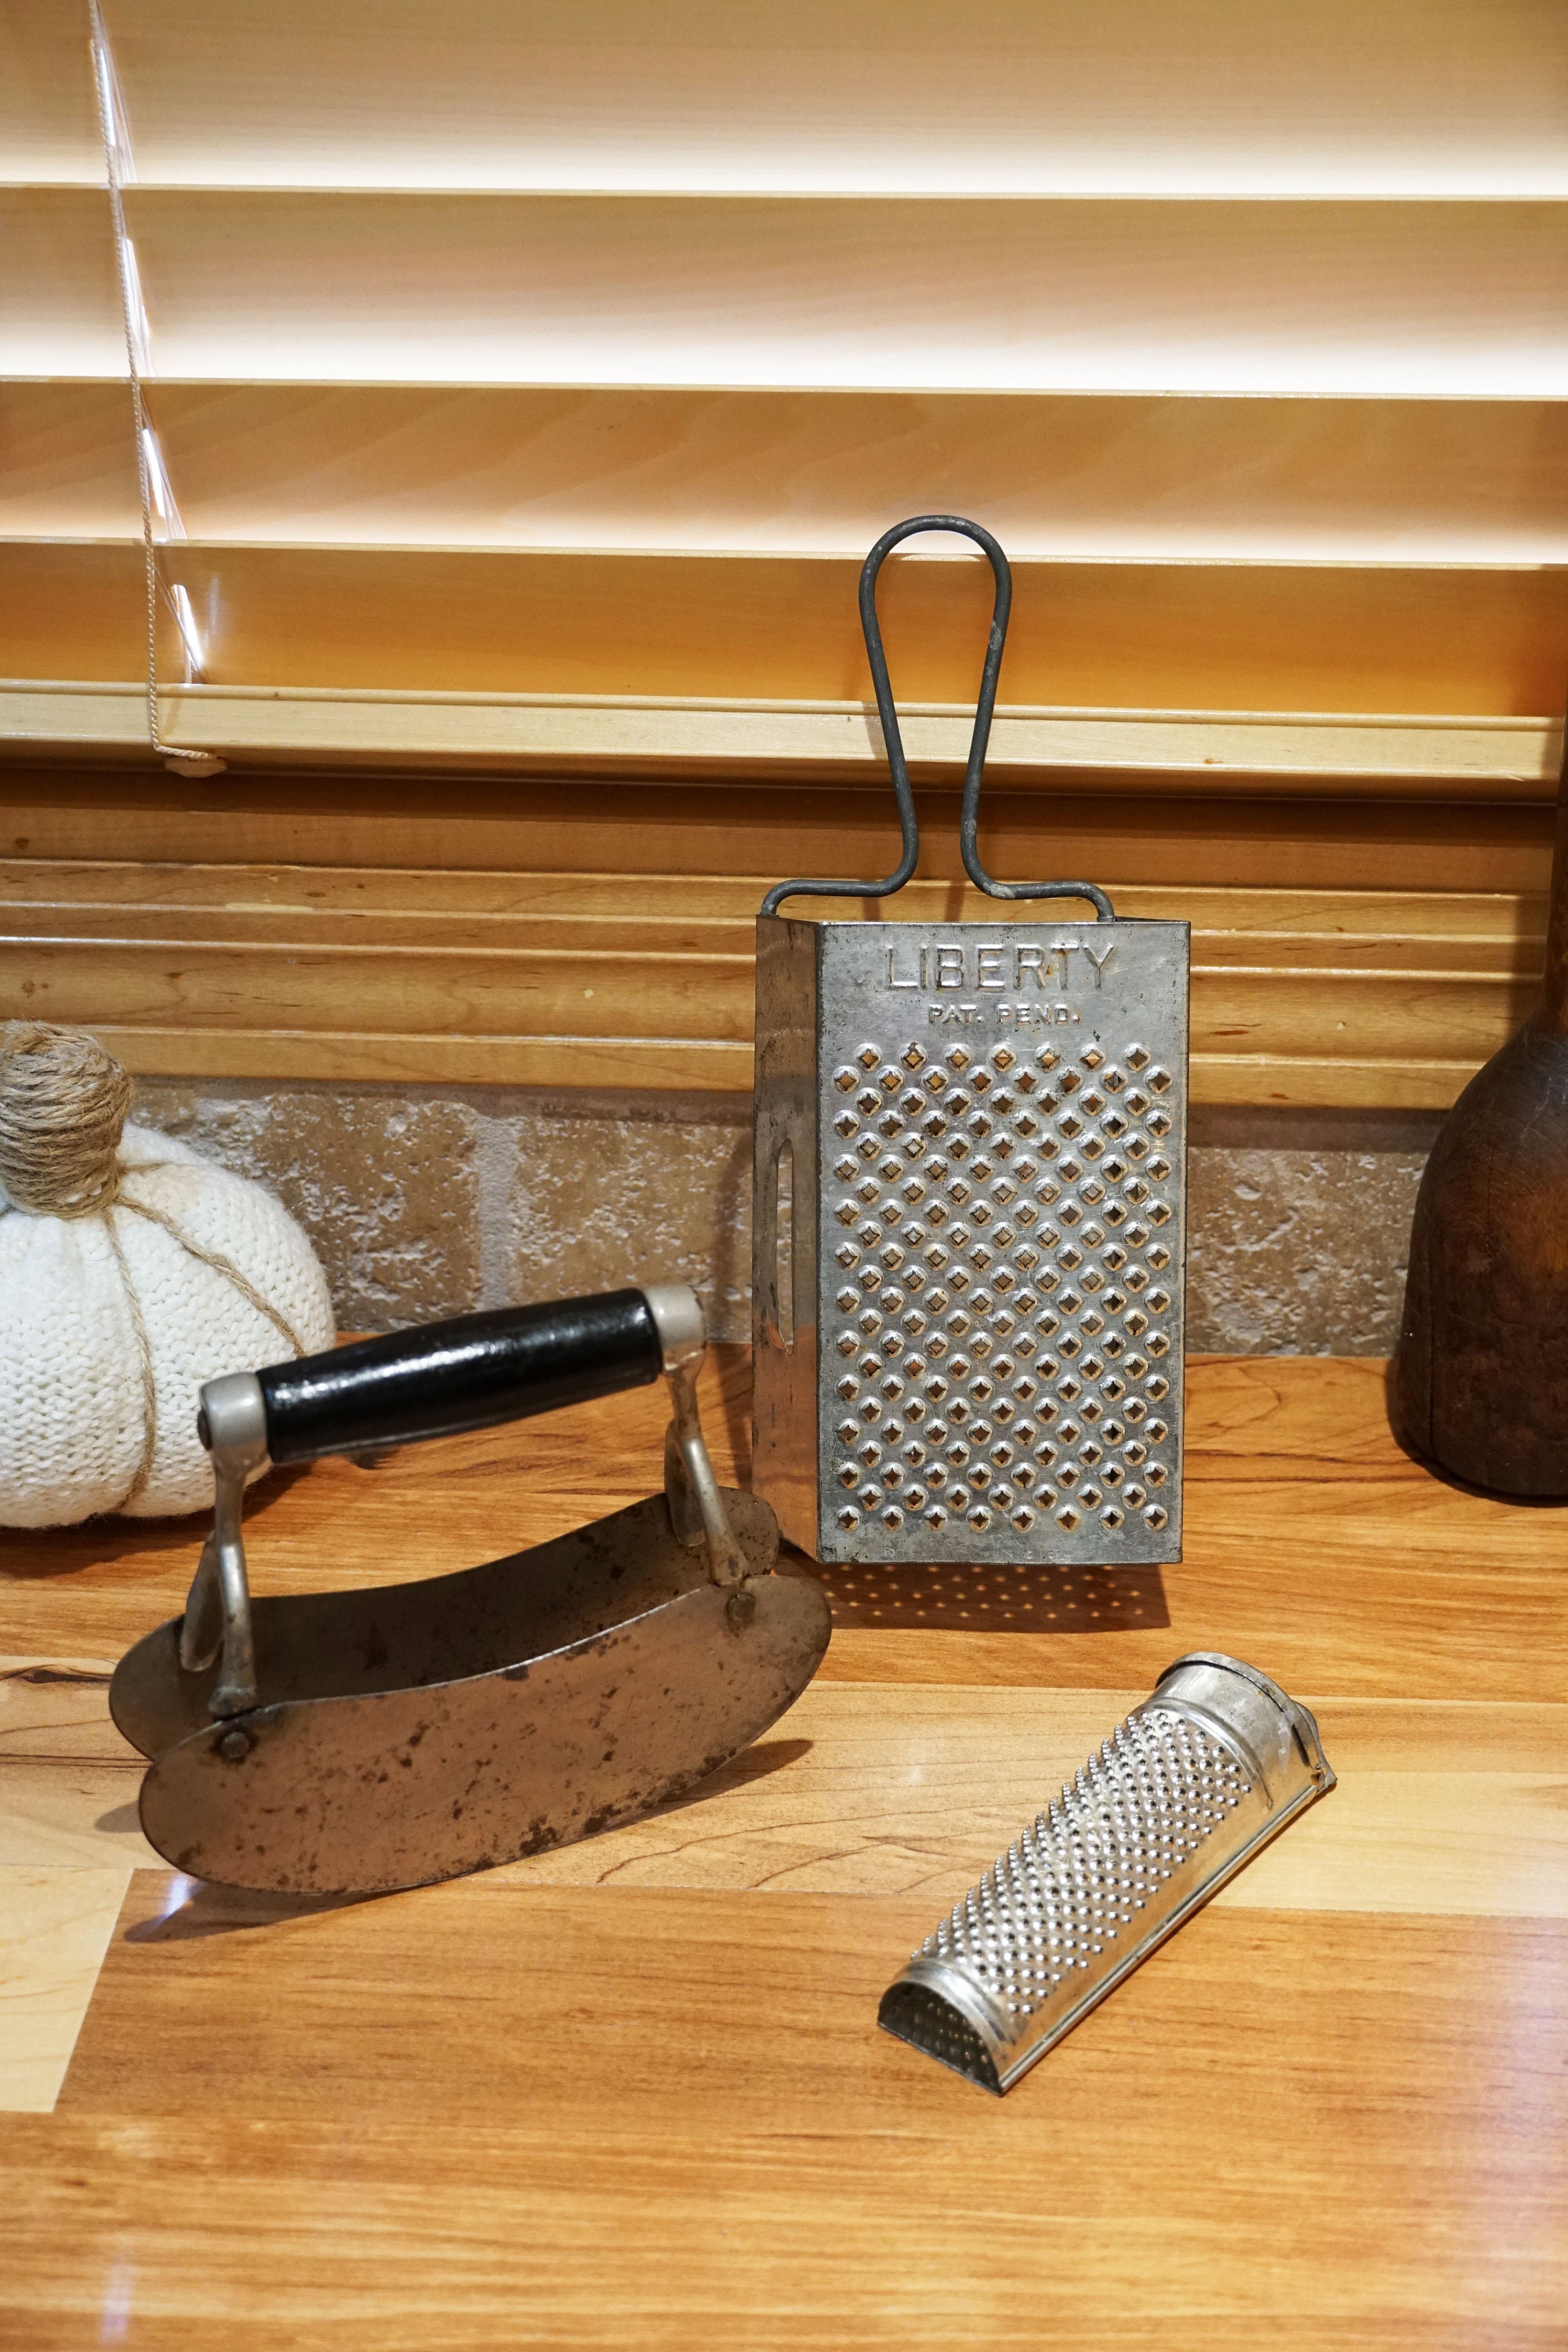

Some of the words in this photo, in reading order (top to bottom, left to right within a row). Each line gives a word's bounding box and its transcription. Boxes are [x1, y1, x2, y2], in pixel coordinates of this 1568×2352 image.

[886, 942, 1115, 990] LIBERTY
[928, 1004, 984, 1025] PAT.
[996, 1003, 1081, 1025] PEND.
